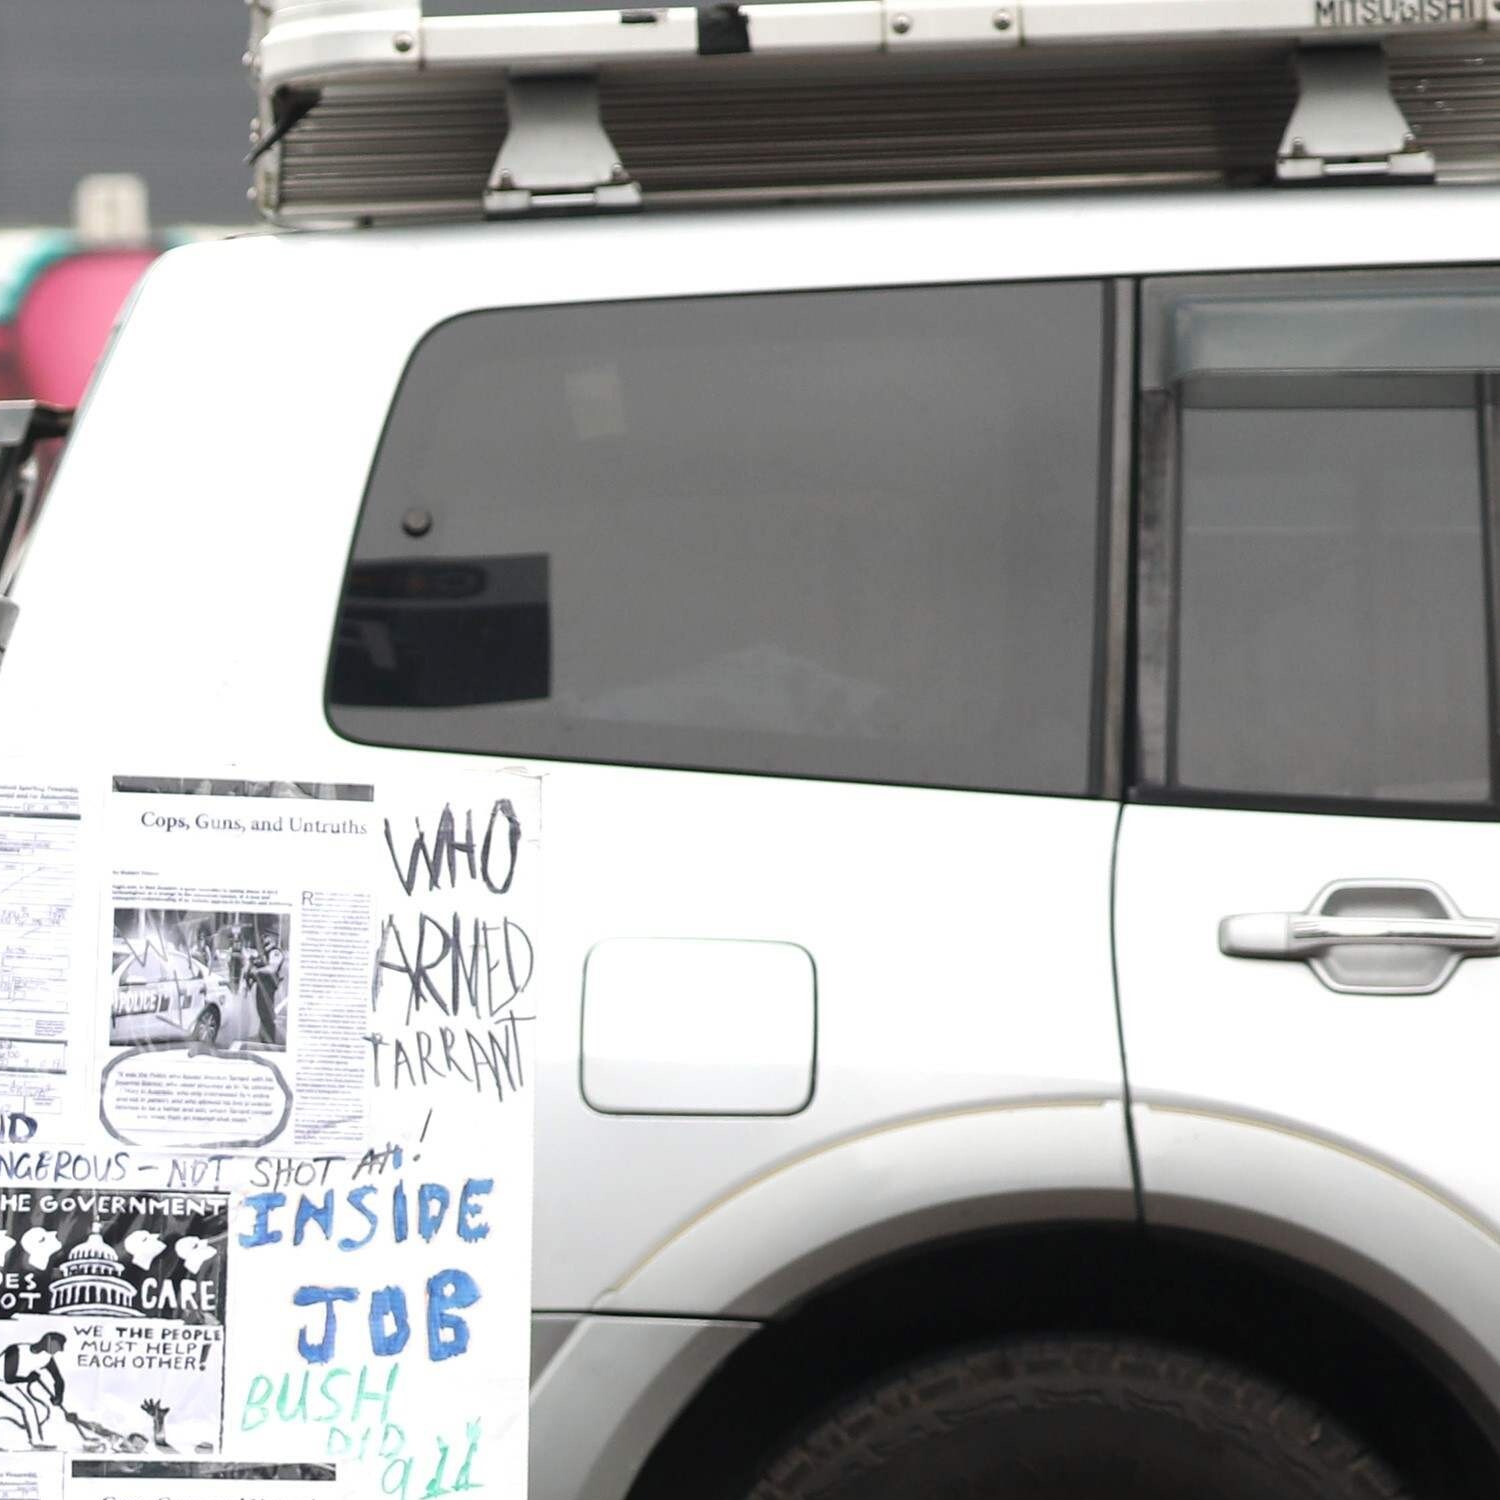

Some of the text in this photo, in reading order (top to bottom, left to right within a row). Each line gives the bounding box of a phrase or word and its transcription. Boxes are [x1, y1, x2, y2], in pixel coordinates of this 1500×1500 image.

[140, 810, 369, 836] Cops, Guns, and Untruths
[383, 797, 522, 896] WHO
[372, 910, 535, 1026] ARMED
[362, 1010, 537, 1103] TARRANT
[165, 1154, 234, 1190] NOT
[249, 1156, 346, 1191] SHOT
[39, 1195, 228, 1217] GOVERNMENT
[238, 1178, 495, 1252] INSIDE
[141, 1277, 216, 1311] CARE
[73, 1325, 222, 1342] WE THE PEOPLE
[292, 1267, 483, 1365] JOB
[77, 1355, 126, 1368] EACH
[81, 1341, 138, 1353] MUST
[241, 1362, 400, 1432] BUSH
[326, 1423, 406, 1461] DID
